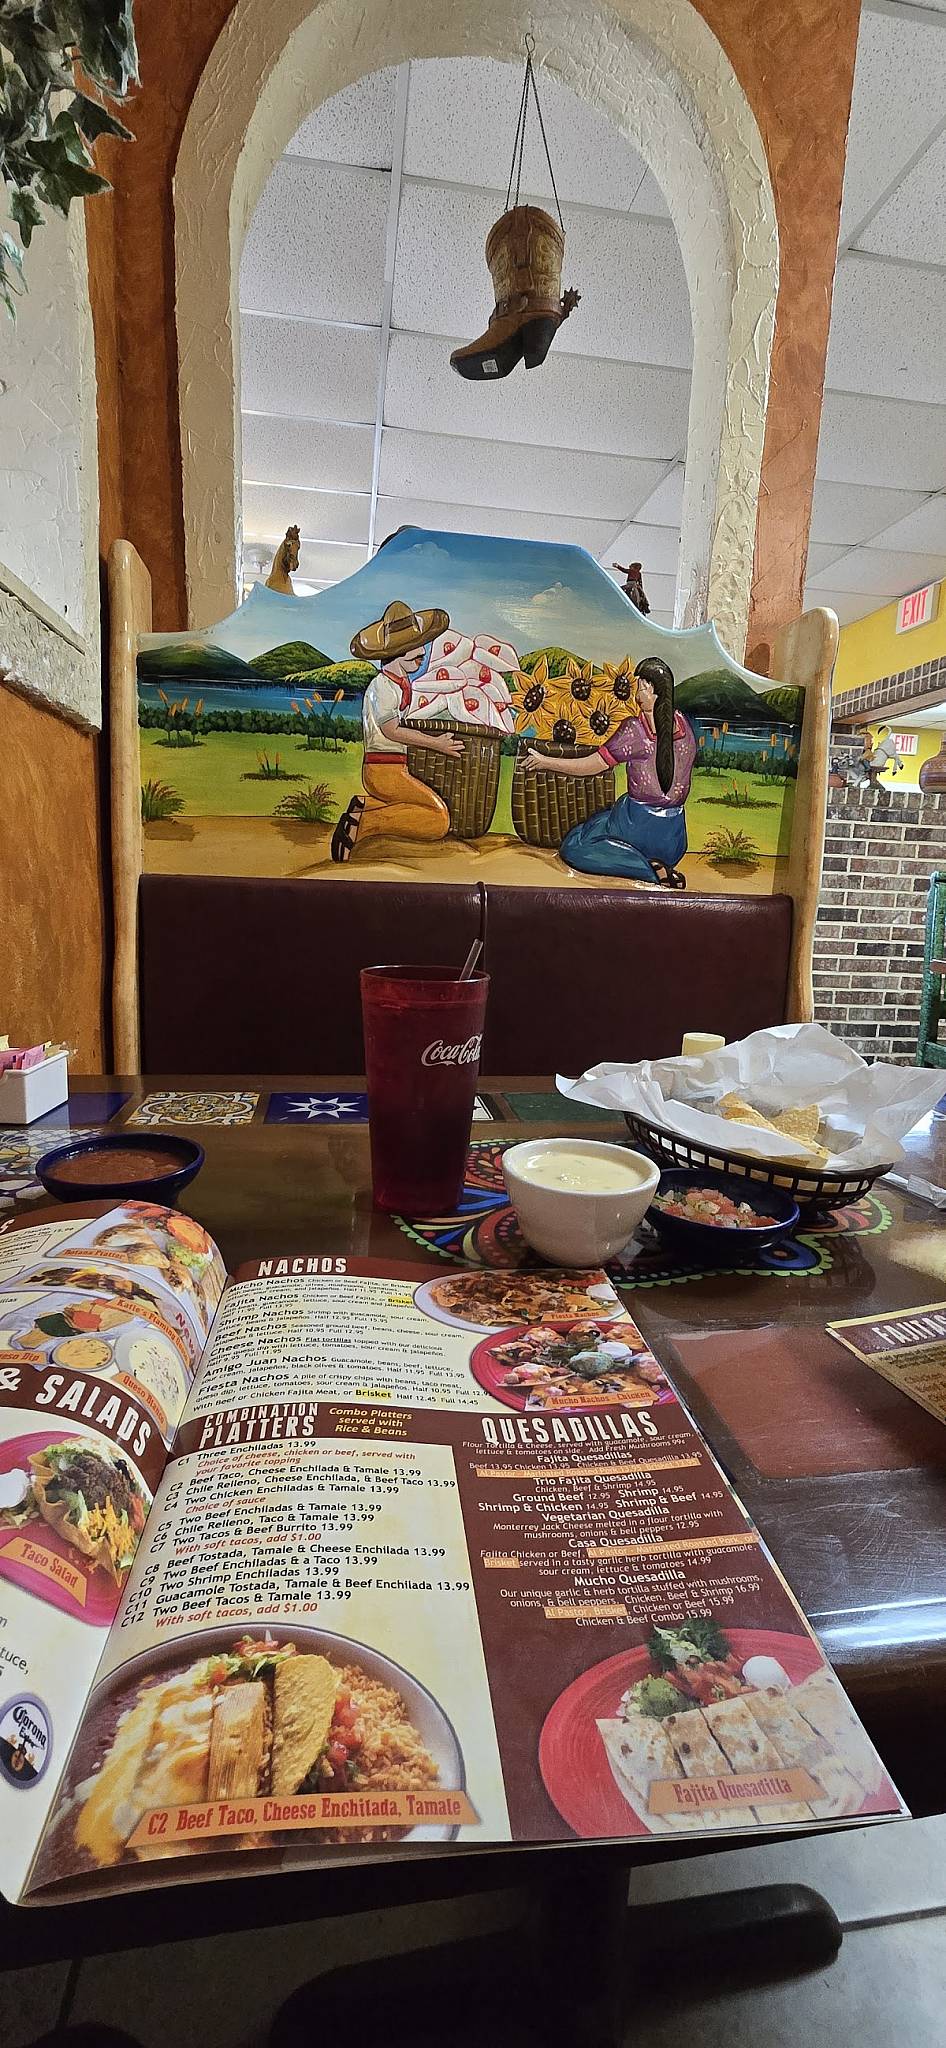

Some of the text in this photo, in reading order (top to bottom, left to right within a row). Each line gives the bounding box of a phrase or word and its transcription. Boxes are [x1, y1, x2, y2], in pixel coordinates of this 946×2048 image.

[902, 589, 928, 628] EXIT
[895, 735, 914, 752] EXIT
[258, 1258, 346, 1276] NACHOS
[230, 1281, 263, 1292] Mucho
[225, 1298, 255, 1309] Fajita
[220, 1309, 303, 1327] Shrimp Nachos
[215, 1322, 287, 1341] Beef Nachos
[211, 1336, 302, 1356] Cheese Nachos
[22, 1352, 40, 1361] Dip
[204, 1355, 327, 1377] Amigo Juan Nachos
[123, 1374, 146, 1400] Queso
[199, 1373, 289, 1395] Fiesta Nachos
[193, 1402, 212, 1410] With
[214, 1397, 235, 1407] Beef
[251, 1391, 285, 1399] Chicken
[288, 1388, 312, 1396] Fajita
[315, 1388, 340, 1396] Meat,
[356, 1389, 391, 1398] Brisket
[551, 1396, 579, 1404] Mucho
[617, 1391, 650, 1400] Chicken
[36, 1374, 152, 1456] SALADS
[204, 1403, 318, 1428] COMBINATION
[329, 1408, 412, 1420] Combo Platters
[379, 1419, 402, 1427] with
[199, 1416, 315, 1449] PLATTERS
[335, 1425, 359, 1433] Rice
[374, 1427, 407, 1436] Beans
[482, 1411, 658, 1445] QUESADILLAS
[197, 1450, 227, 1460] Three
[230, 1442, 284, 1454] Enchiladas
[287, 1440, 316, 1448] 13.99
[537, 1451, 632, 1464] Fajita Quesadillas
[186, 1484, 214, 1495] Chile
[215, 1477, 259, 1491] Relleno,
[264, 1474, 303, 1484] Cheese
[306, 1473, 360, 1484] Enchilada,
[374, 1476, 398, 1485] Beef
[401, 1477, 424, 1486] Taco
[427, 1479, 455, 1488] 13.99
[190, 1474, 213, 1486] Beef
[216, 1470, 244, 1484] Taco,
[249, 1466, 286, 1477] Cheese
[290, 1464, 339, 1473] Enchilada
[353, 1465, 389, 1476] Tamale
[393, 1468, 421, 1477] 13.99
[559, 1475, 592, 1485] Fajita
[594, 1472, 651, 1483] Quesadilla
[479, 1503, 520, 1513] Shrimp
[535, 1502, 582, 1511] Chicken
[616, 1498, 655, 1509] Shrimp
[669, 1492, 696, 1502] Beef
[701, 1491, 723, 1499] 14.95
[513, 1493, 556, 1502] Ground
[559, 1493, 583, 1501] Beef
[618, 1487, 658, 1498] Shrimp
[662, 1485, 684, 1493] 14.95
[186, 1502, 220, 1514] Choice
[238, 1497, 266, 1505] sauce
[543, 1506, 670, 1522] Vegetarian Quesadilla
[568, 1534, 663, 1548] Casa Quesadilla
[22, 1542, 78, 1588] Taco Salad
[167, 1556, 195, 1569] Beef
[198, 1549, 246, 1562] Tostada,
[251, 1544, 293, 1555] Tamale
[310, 1544, 351, 1554] Cheese
[355, 1544, 409, 1556] Enchilada
[414, 1547, 445, 1557] 13.99
[129, 1566, 339, 1604] C10 Two Shrimp Enchiladas 13.99
[574, 1570, 686, 1587] Mucho Quesadilla
[121, 1612, 144, 1628] C12
[153, 1604, 177, 1617] Two
[182, 1598, 211, 1611] Beef
[216, 1593, 249, 1607] Tacos
[268, 1590, 311, 1601] Tamale
[316, 1590, 351, 1601] 13.99
[156, 1603, 317, 1628] With soft tacos, add $1.00
[576, 1617, 613, 1626] Chicken
[627, 1615, 648, 1624] Beef
[651, 1612, 683, 1622] Combo
[686, 1610, 712, 1619] 15.99
[12, 1706, 46, 1748] Corona
[674, 1778, 792, 1805] Fajita Quesadilla
[176, 1808, 213, 1832] Beef
[218, 1804, 258, 1828] Taco,
[262, 1799, 316, 1822] Cheese
[322, 1795, 402, 1818] Enchilada,
[406, 1798, 461, 1815] Tamale
